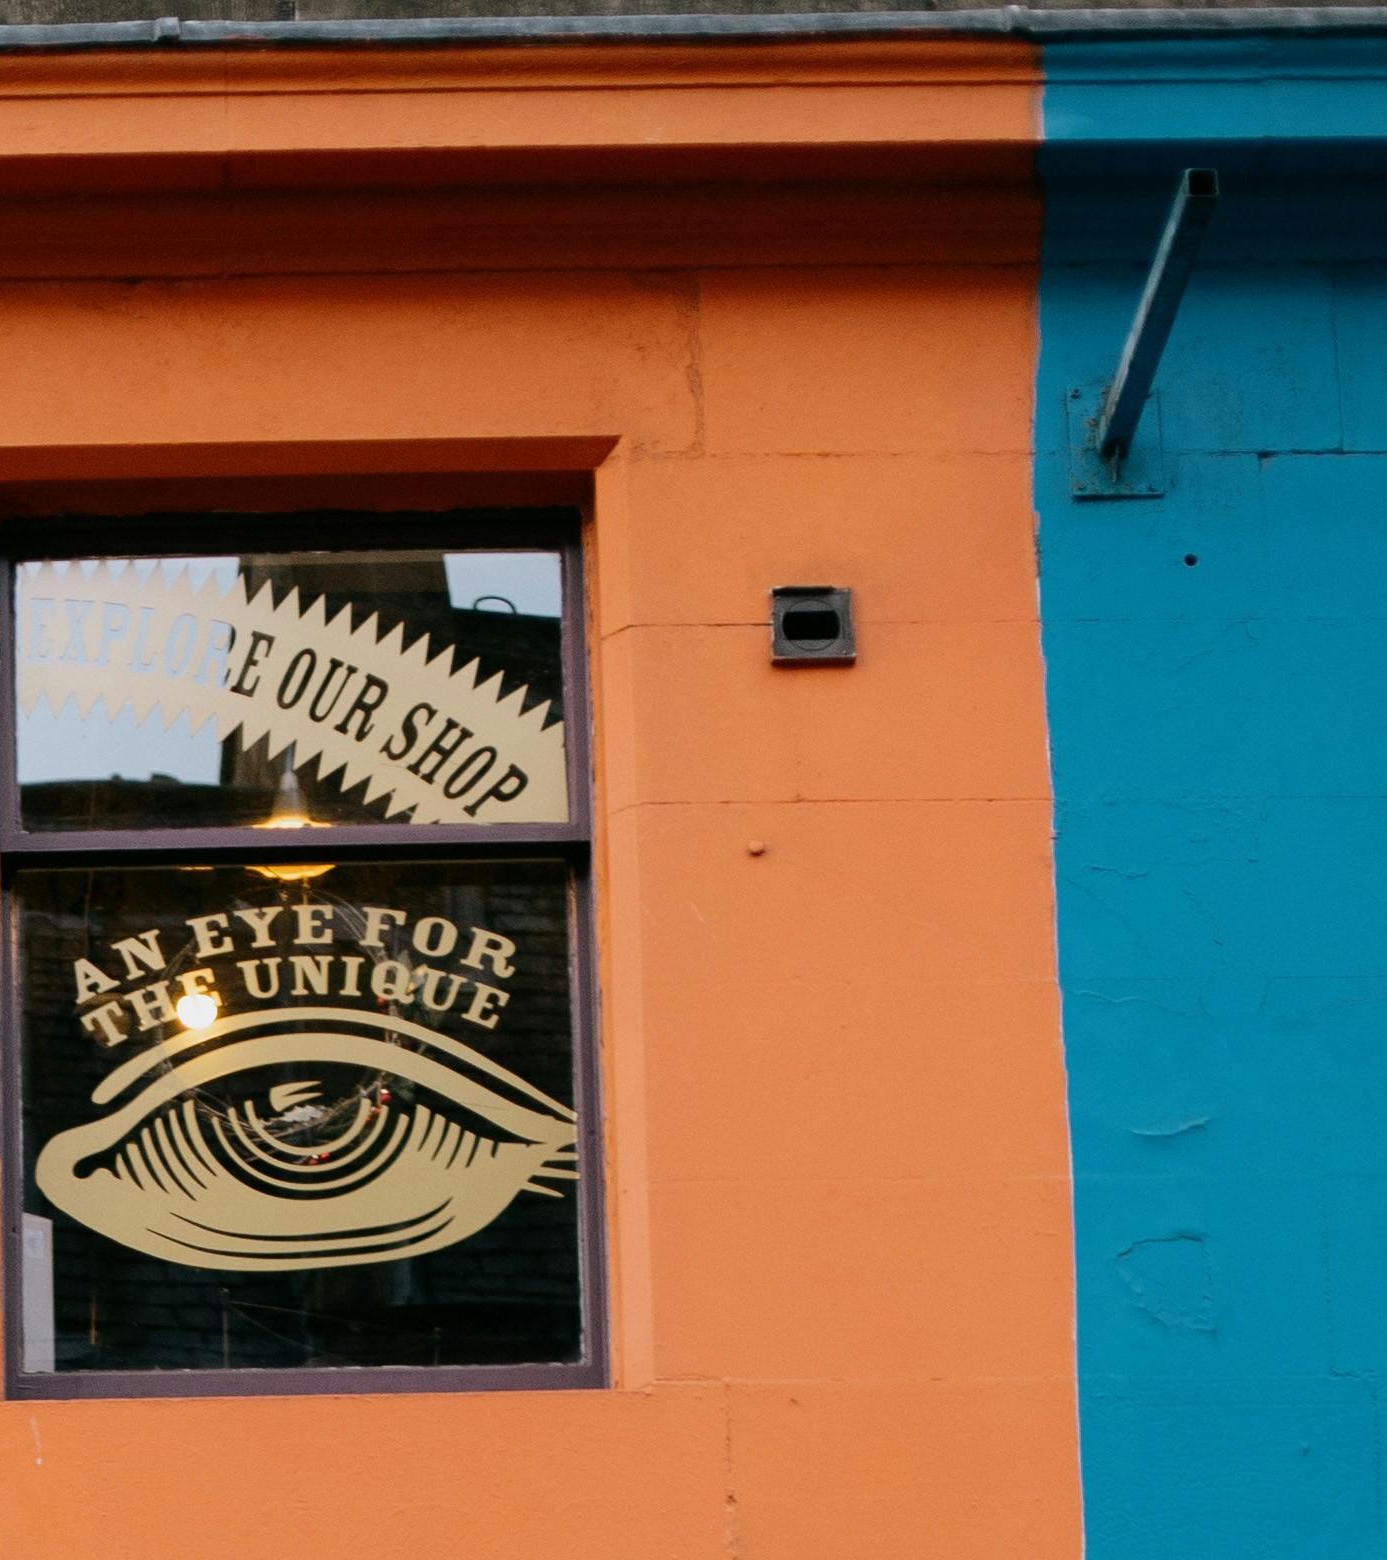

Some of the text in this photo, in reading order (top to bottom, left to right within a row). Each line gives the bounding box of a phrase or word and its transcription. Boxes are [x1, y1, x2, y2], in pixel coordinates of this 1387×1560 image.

[31, 596, 529, 818] EXPLORE OUR SHOP
[74, 904, 518, 1003] AN EYE FOR
[80, 954, 510, 1048] THE UNIQUE
